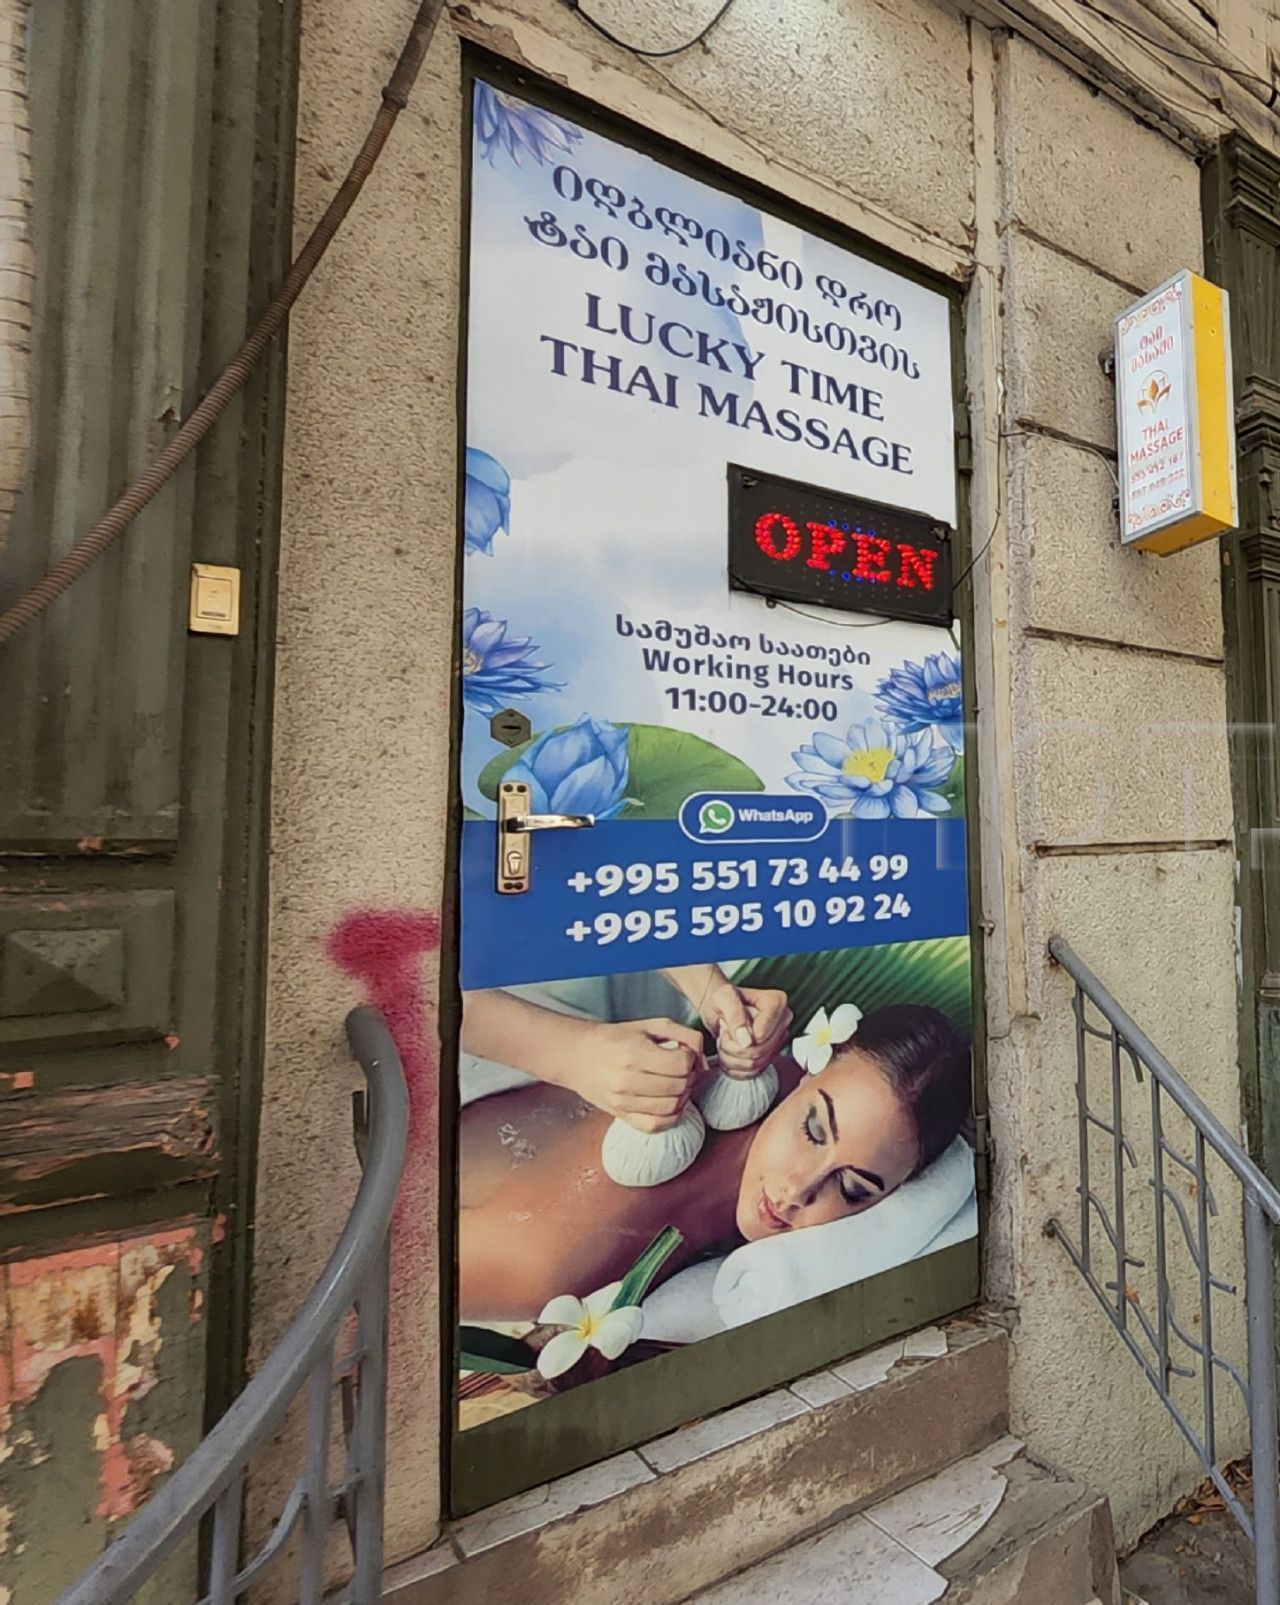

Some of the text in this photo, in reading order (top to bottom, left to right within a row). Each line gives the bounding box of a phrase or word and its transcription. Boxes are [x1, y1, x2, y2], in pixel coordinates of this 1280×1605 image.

[553, 165, 902, 331] იღბლიანი დრო
[524, 211, 920, 380] ტაი მასაჟისთვის
[585, 292, 885, 422] LUCKY TIME
[540, 335, 914, 475] THAI MASSAGE
[1142, 418, 1168, 441] THAI
[1129, 427, 1184, 465] MASSAGE
[754, 512, 939, 591] OPEN
[616, 614, 871, 667] სამუშაო საათები
[642, 648, 854, 691] Working Hours
[664, 687, 838, 721] 11:00-24:00
[738, 808, 813, 825] WhatsApp
[567, 854, 909, 898] +995 551 73 44 99
[565, 893, 912, 945] +995 595 10 92 24
